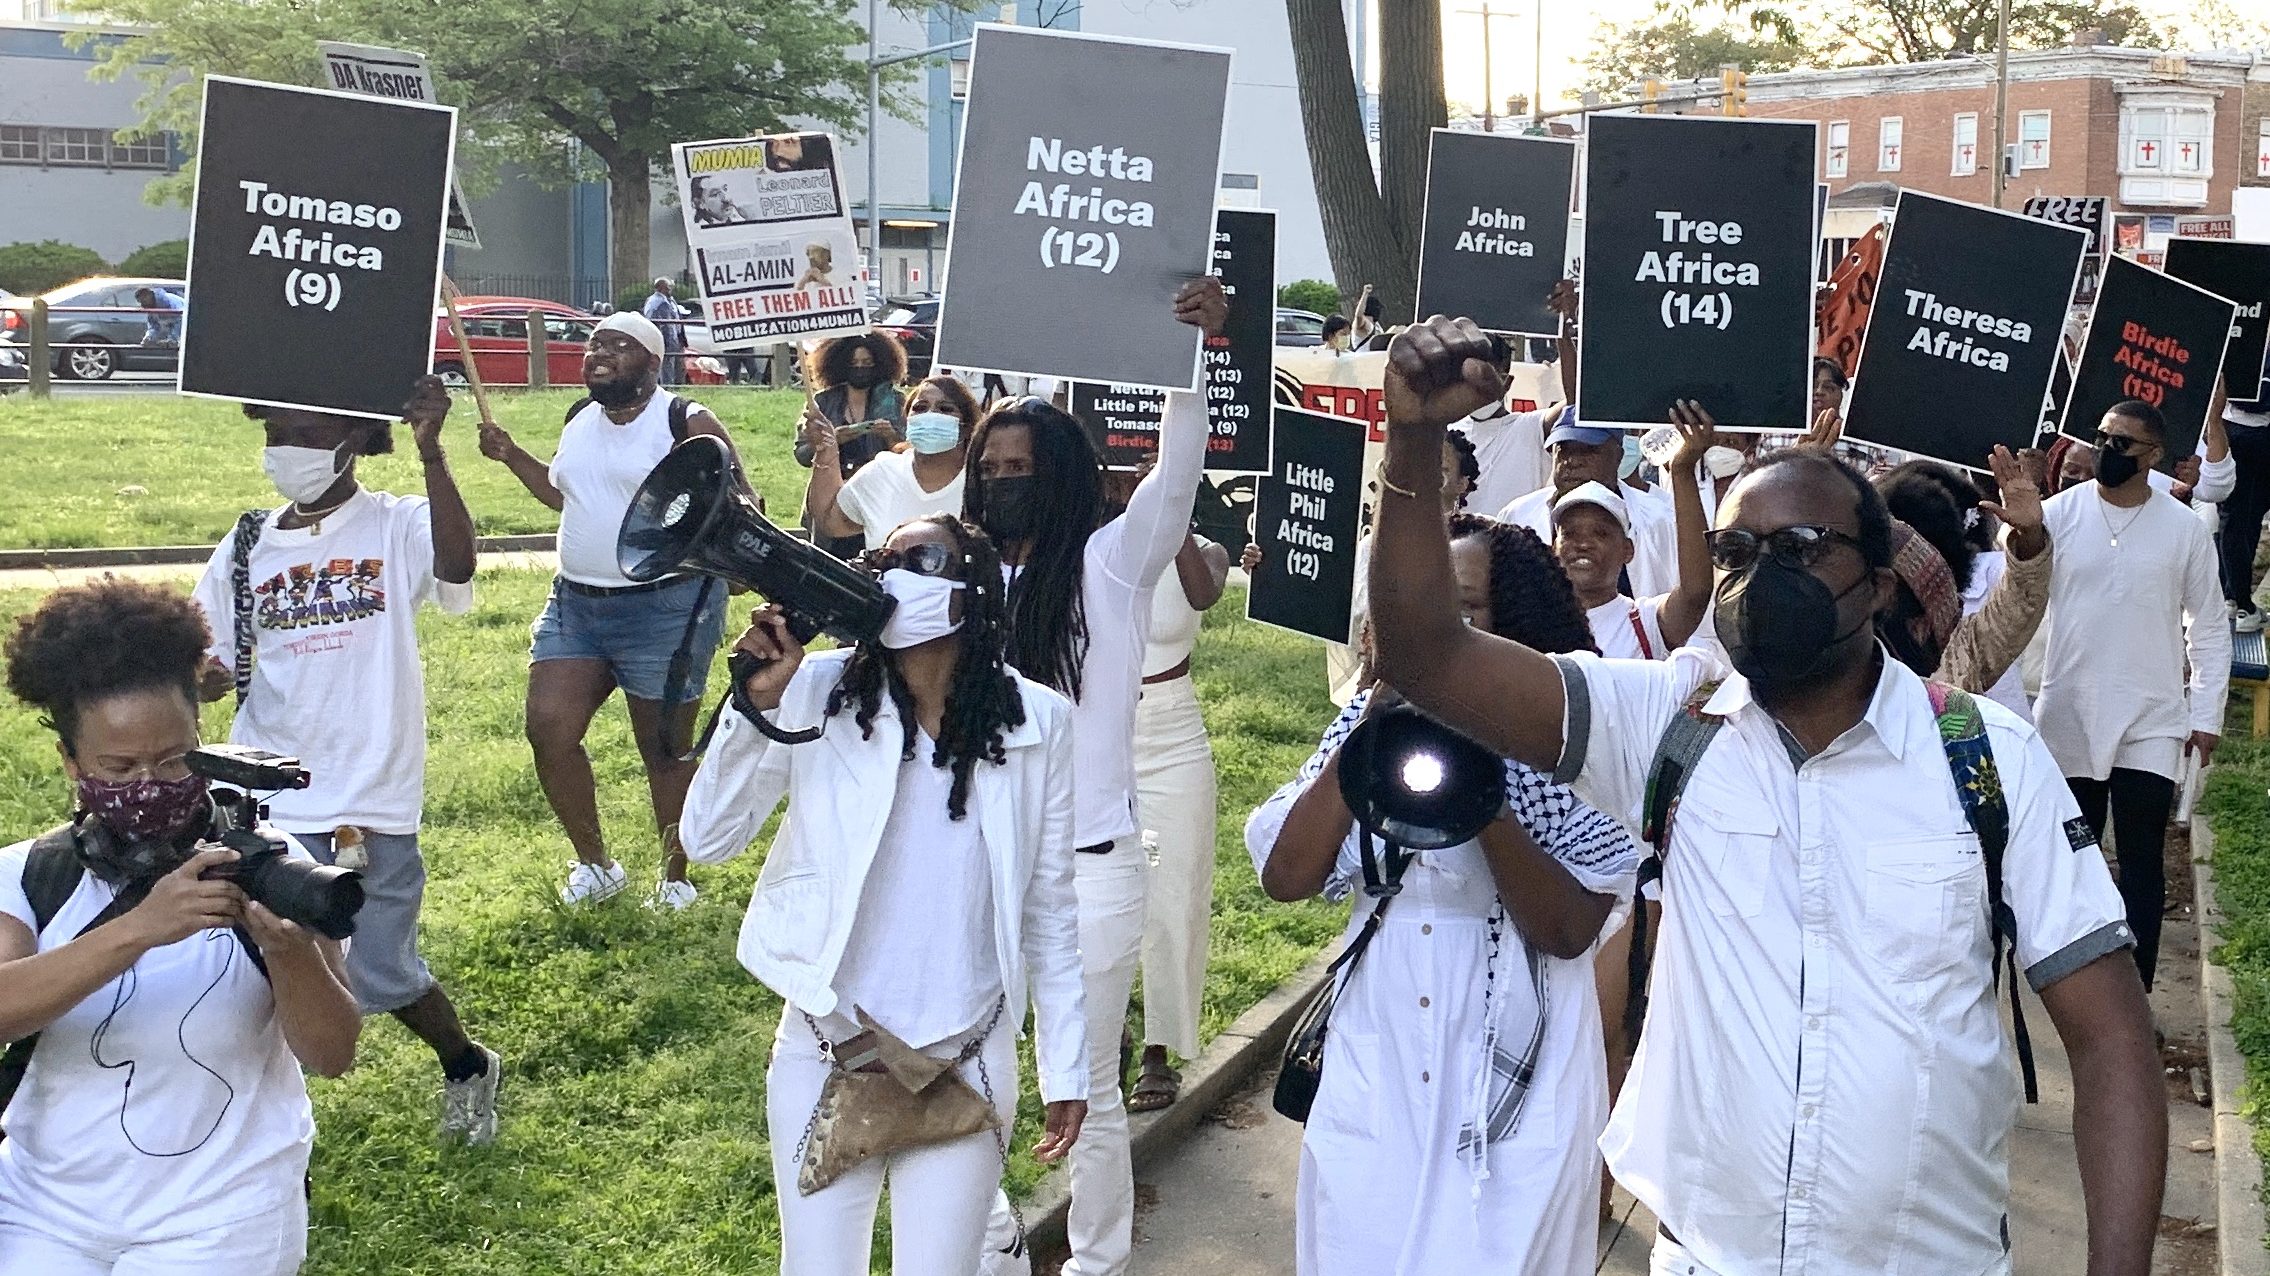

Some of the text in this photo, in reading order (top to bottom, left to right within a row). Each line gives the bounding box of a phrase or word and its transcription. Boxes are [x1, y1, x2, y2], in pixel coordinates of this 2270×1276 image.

[331, 62, 424, 99] DA Krasner
[692, 146, 764, 172] MUMIA
[1027, 136, 1153, 182] Netta
[756, 172, 830, 193] Leonard
[239, 180, 402, 231] Tomaso
[760, 192, 835, 216] PELTIER
[1013, 181, 1154, 227] Africa
[1467, 206, 1525, 231] John
[2027, 197, 2097, 223] FREE
[1655, 210, 1743, 245] Tree
[2181, 221, 2230, 234] FREE ALL
[249, 225, 383, 271] Africa
[1040, 226, 1120, 274] (12)
[1455, 231, 1534, 258] Africa
[712, 258, 795, 286] AL-AMIN
[1635, 251, 1760, 286] Africa
[285, 268, 341, 312] (9)
[712, 286, 856, 321] FREE THEM ALL!
[1661, 289, 1732, 331] (14)
[1904, 289, 2032, 343] Theresa
[713, 312, 863, 342] MOBILIZATION4MUMIA
[2121, 320, 2190, 364] Birdie
[1205, 351, 1231, 366] (14)
[1907, 326, 2010, 372] Africa
[1215, 368, 1242, 383] (13)
[2113, 345, 2185, 388] Africa
[1208, 385, 1235, 400] (12)
[2123, 372, 2166, 407] (13)
[1094, 398, 1136, 413] Little
[1139, 400, 1164, 415] Phi
[1222, 404, 1250, 419] (12)
[1105, 416, 1161, 431] Tomaso
[1217, 421, 1238, 436] (9)
[1106, 434, 1234, 451] Birdie (13)
[1286, 462, 1335, 494] Little
[1290, 492, 1326, 521] Phil
[1277, 518, 1334, 553] Africa
[1286, 548, 1320, 581] (12)
